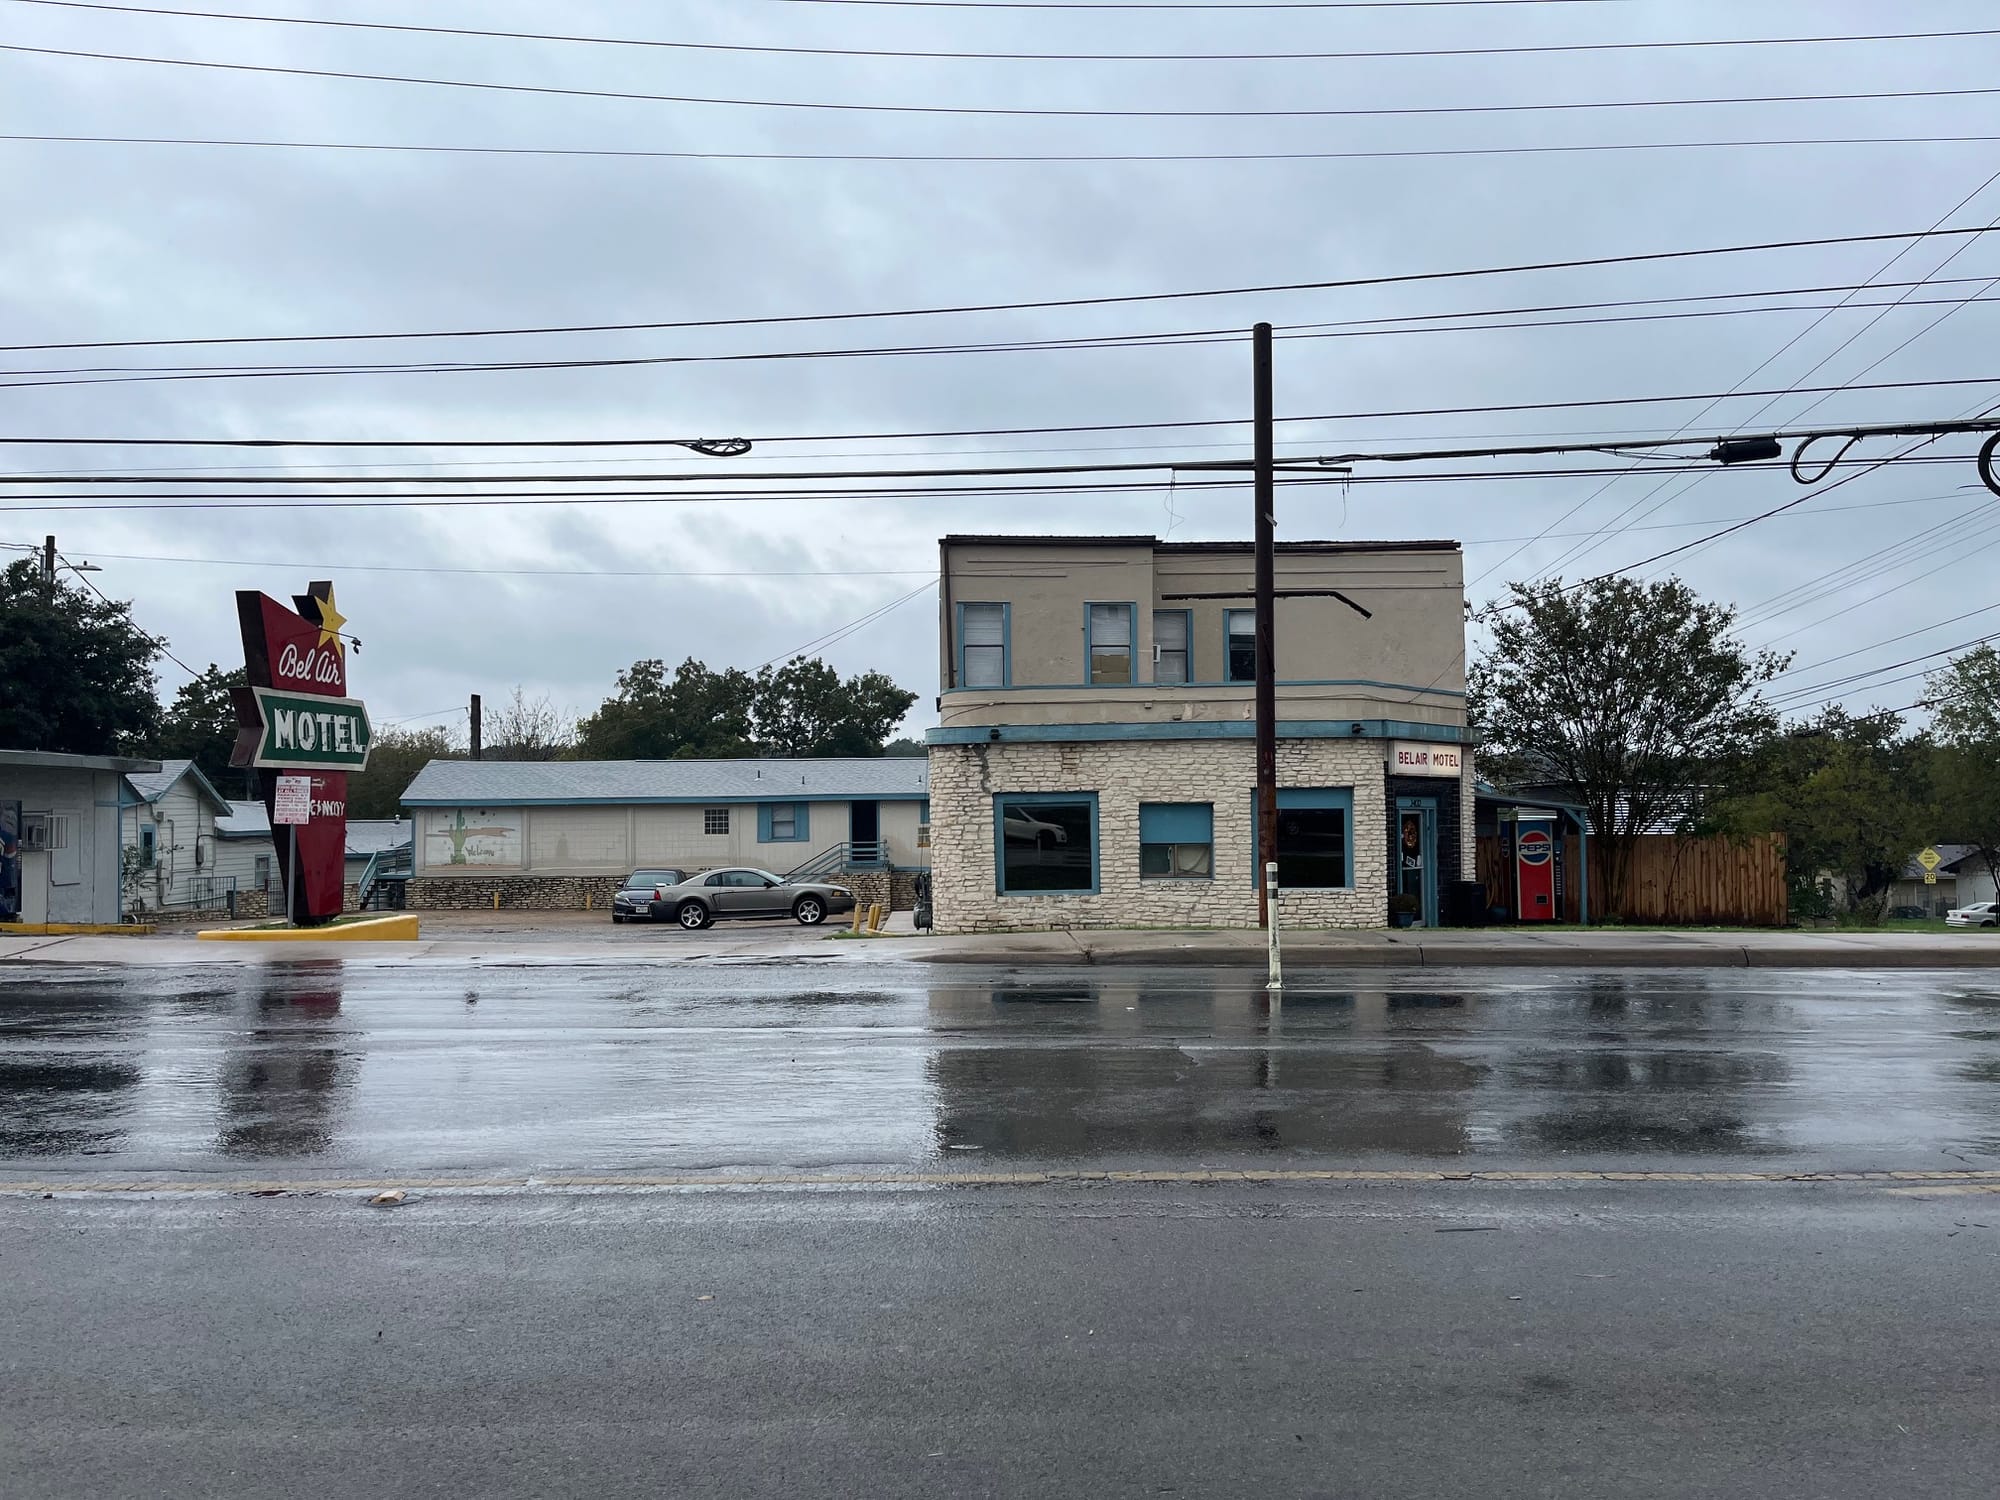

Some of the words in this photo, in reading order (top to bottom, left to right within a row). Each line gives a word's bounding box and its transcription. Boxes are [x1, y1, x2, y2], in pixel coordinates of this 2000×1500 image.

[279, 644, 316, 680] Bel
[315, 651, 341, 685] Air
[274, 708, 367, 754] MOTEL
[1433, 754, 1459, 767] MOTEL
[1519, 844, 1551, 852] PEPSI
